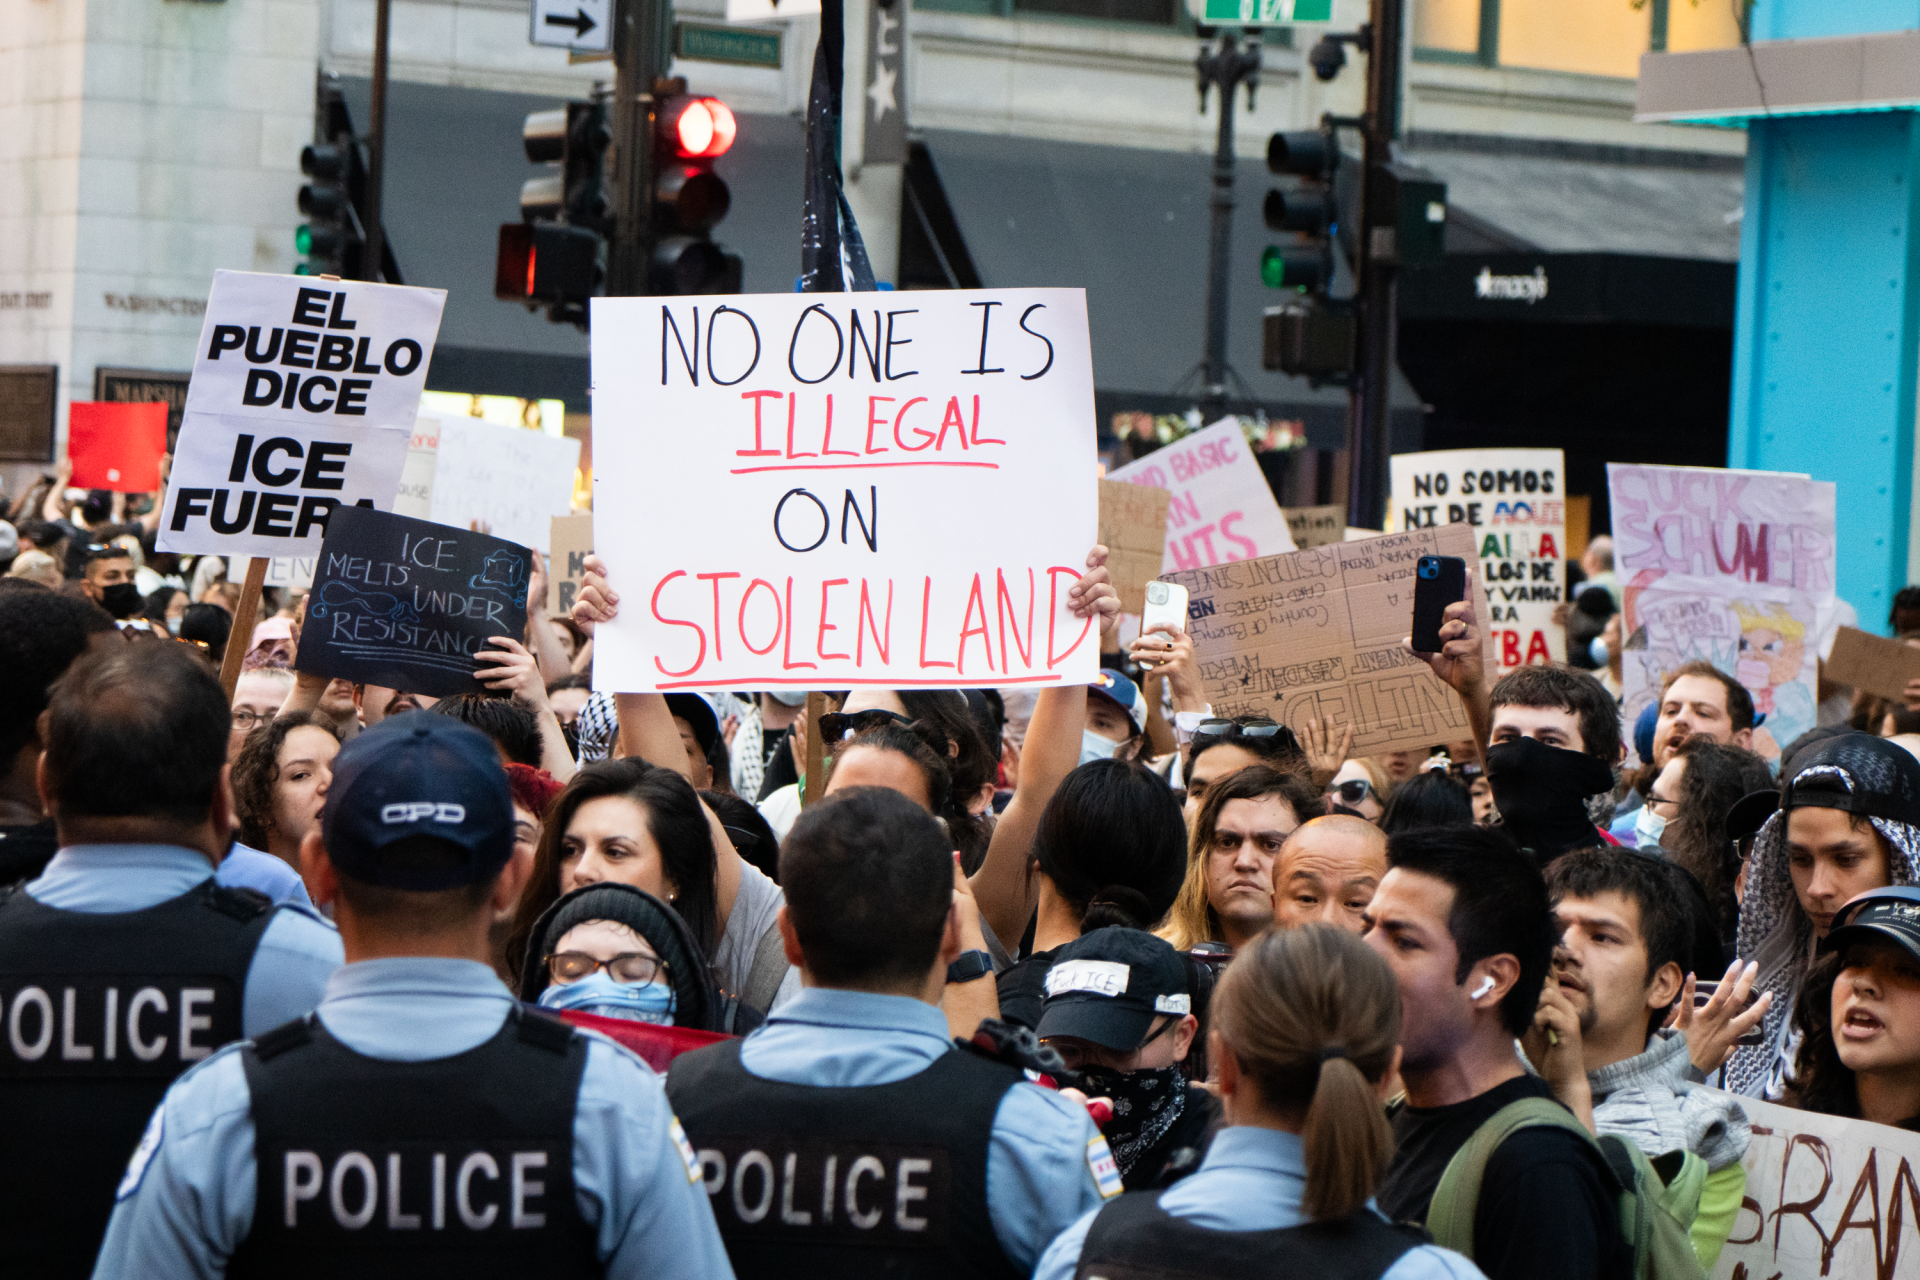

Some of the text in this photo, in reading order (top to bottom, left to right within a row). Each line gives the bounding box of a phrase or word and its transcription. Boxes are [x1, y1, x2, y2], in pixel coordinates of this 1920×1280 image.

[291, 287, 357, 330] EL
[207, 324, 423, 377] PUEBLO
[661, 301, 1055, 387] NO ONE IS
[242, 368, 373, 416] DICE
[736, 389, 1007, 460] ILLEGAL
[228, 433, 353, 490] ICE
[1169, 437, 1239, 483] BASIC
[1414, 469, 1555, 497] NO SOMOS
[169, 487, 375, 538] FUER
[773, 485, 878, 553] ON
[1405, 501, 1565, 530] NI DE AQUI
[1375, 535, 1411, 550] WORK
[1379, 546, 1430, 564] WOMAN
[1417, 532, 1433, 544] TO
[1620, 513, 1833, 592] SCHUMER
[327, 552, 411, 586] MELTS
[1185, 548, 1337, 594] RESIDENT SINCE
[1486, 561, 1555, 582] LOS DE
[414, 585, 511, 634] UNDER
[1500, 586, 1562, 602] VAMOS
[650, 567, 1094, 678] STOLEN LAND
[1491, 629, 1552, 668] BA
[381, 802, 466, 824] CPD
[1085, 971, 1117, 992] ICE
[0, 985, 215, 1062] OLICE
[284, 1151, 548, 1231] POLICE
[697, 1148, 932, 1231] POLICE
